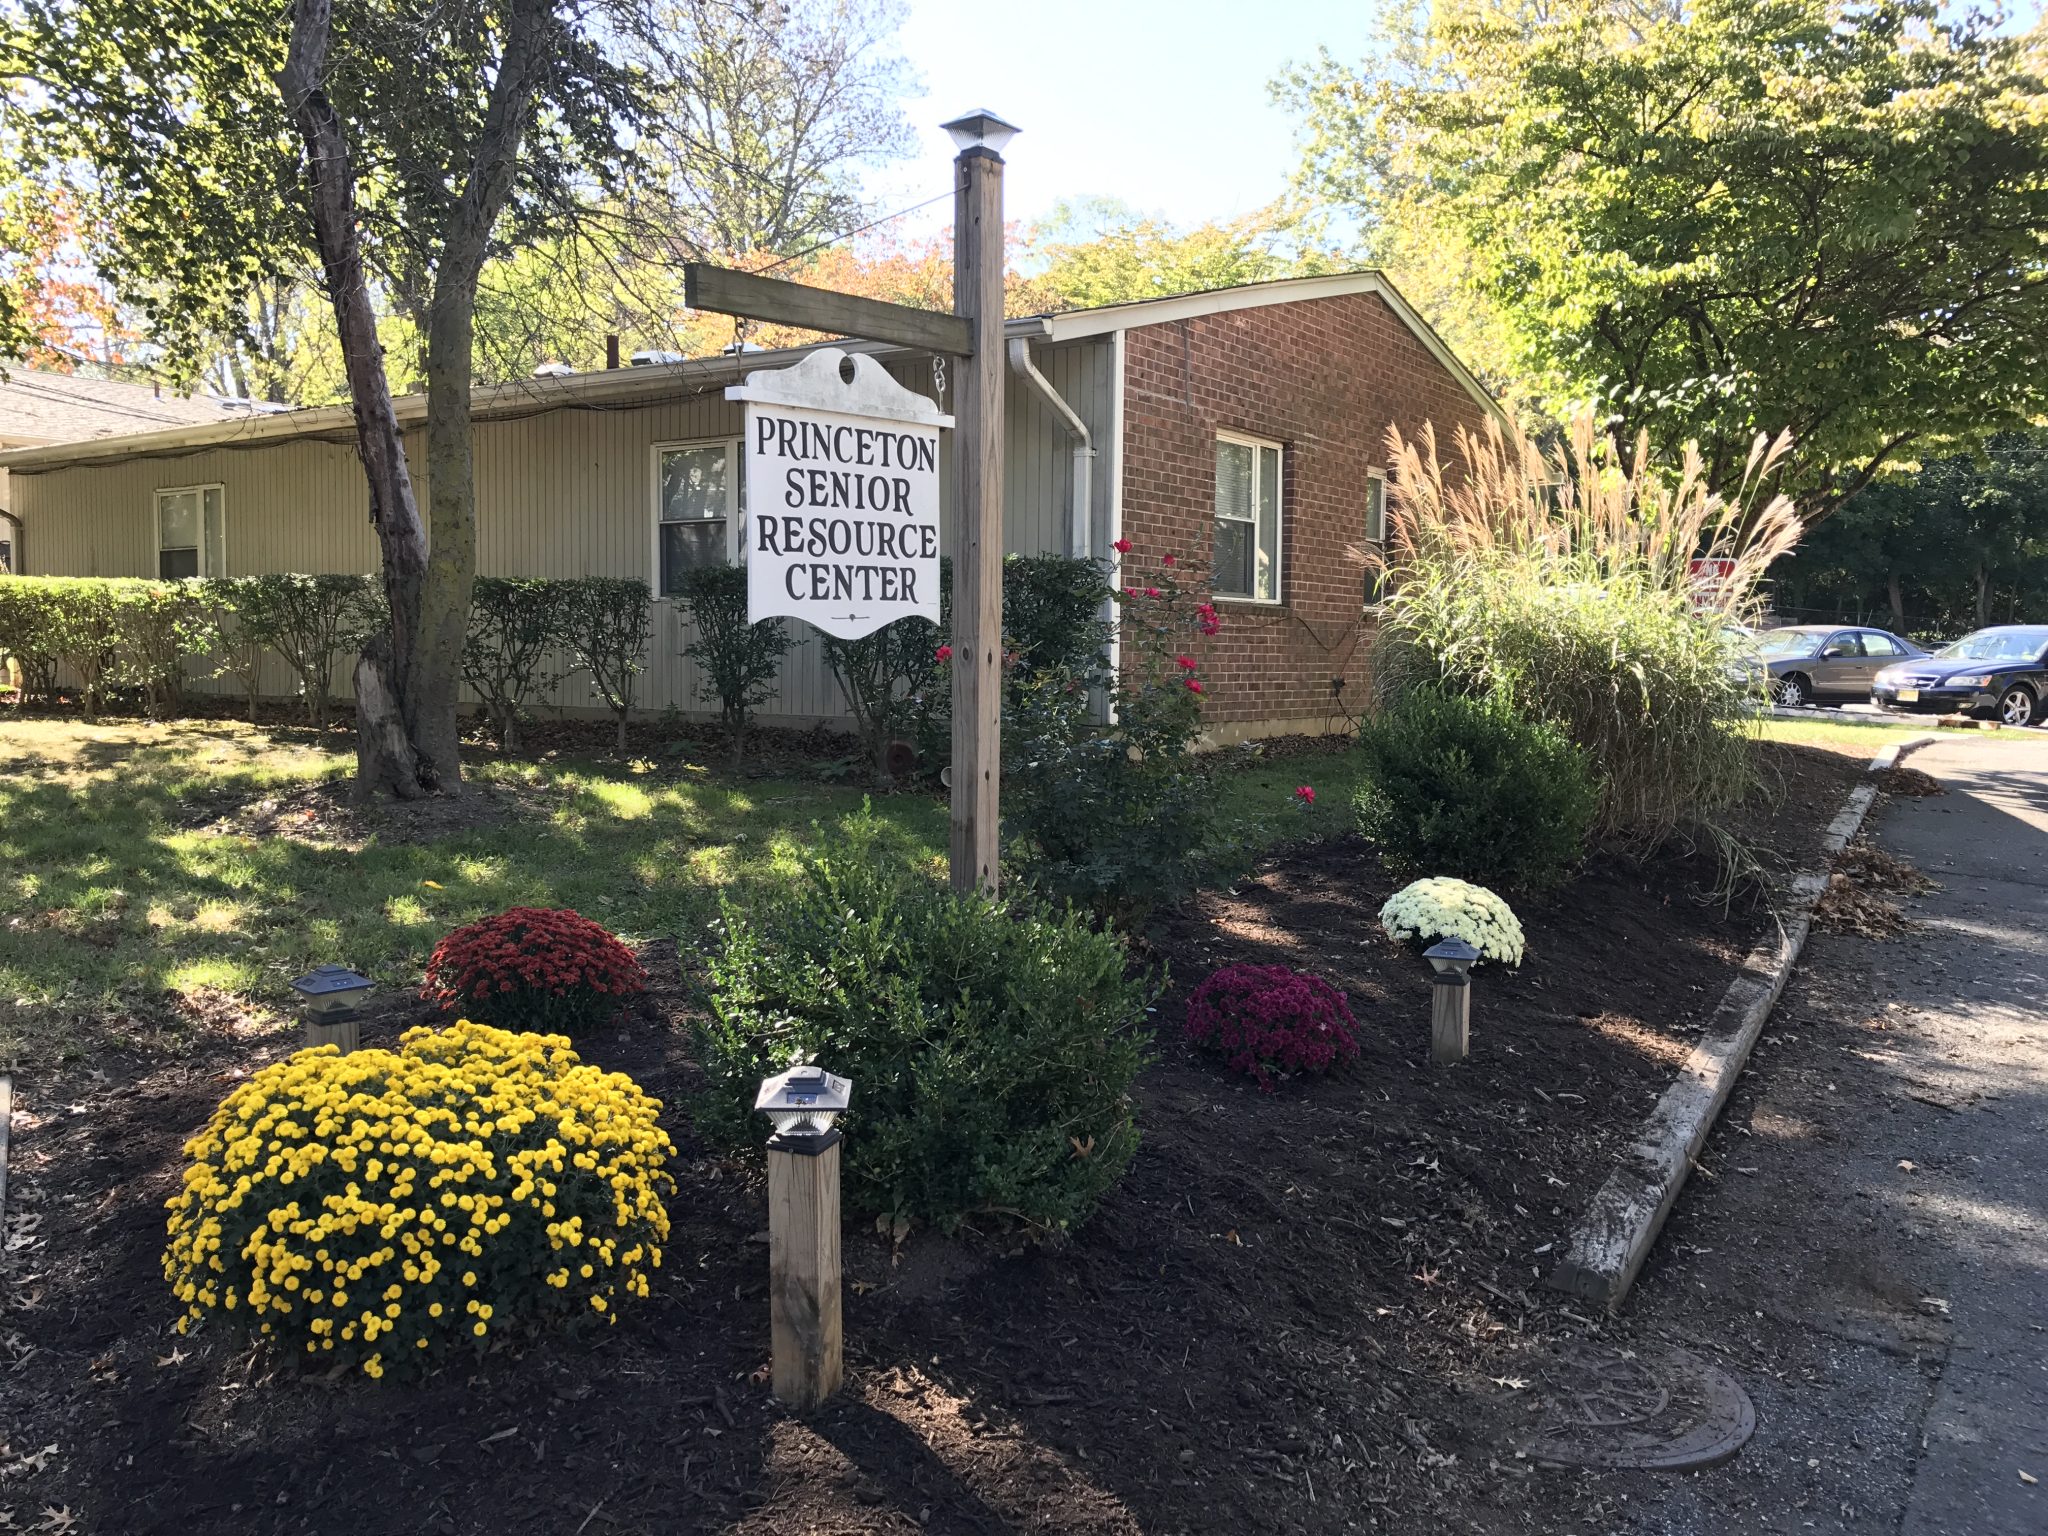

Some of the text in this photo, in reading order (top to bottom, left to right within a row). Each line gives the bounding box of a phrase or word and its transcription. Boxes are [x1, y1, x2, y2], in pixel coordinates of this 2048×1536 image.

[756, 416, 937, 474] PRINCETON
[785, 467, 914, 517] SENIOR
[756, 514, 937, 560] RESOURCE
[785, 563, 919, 605] CENTER
